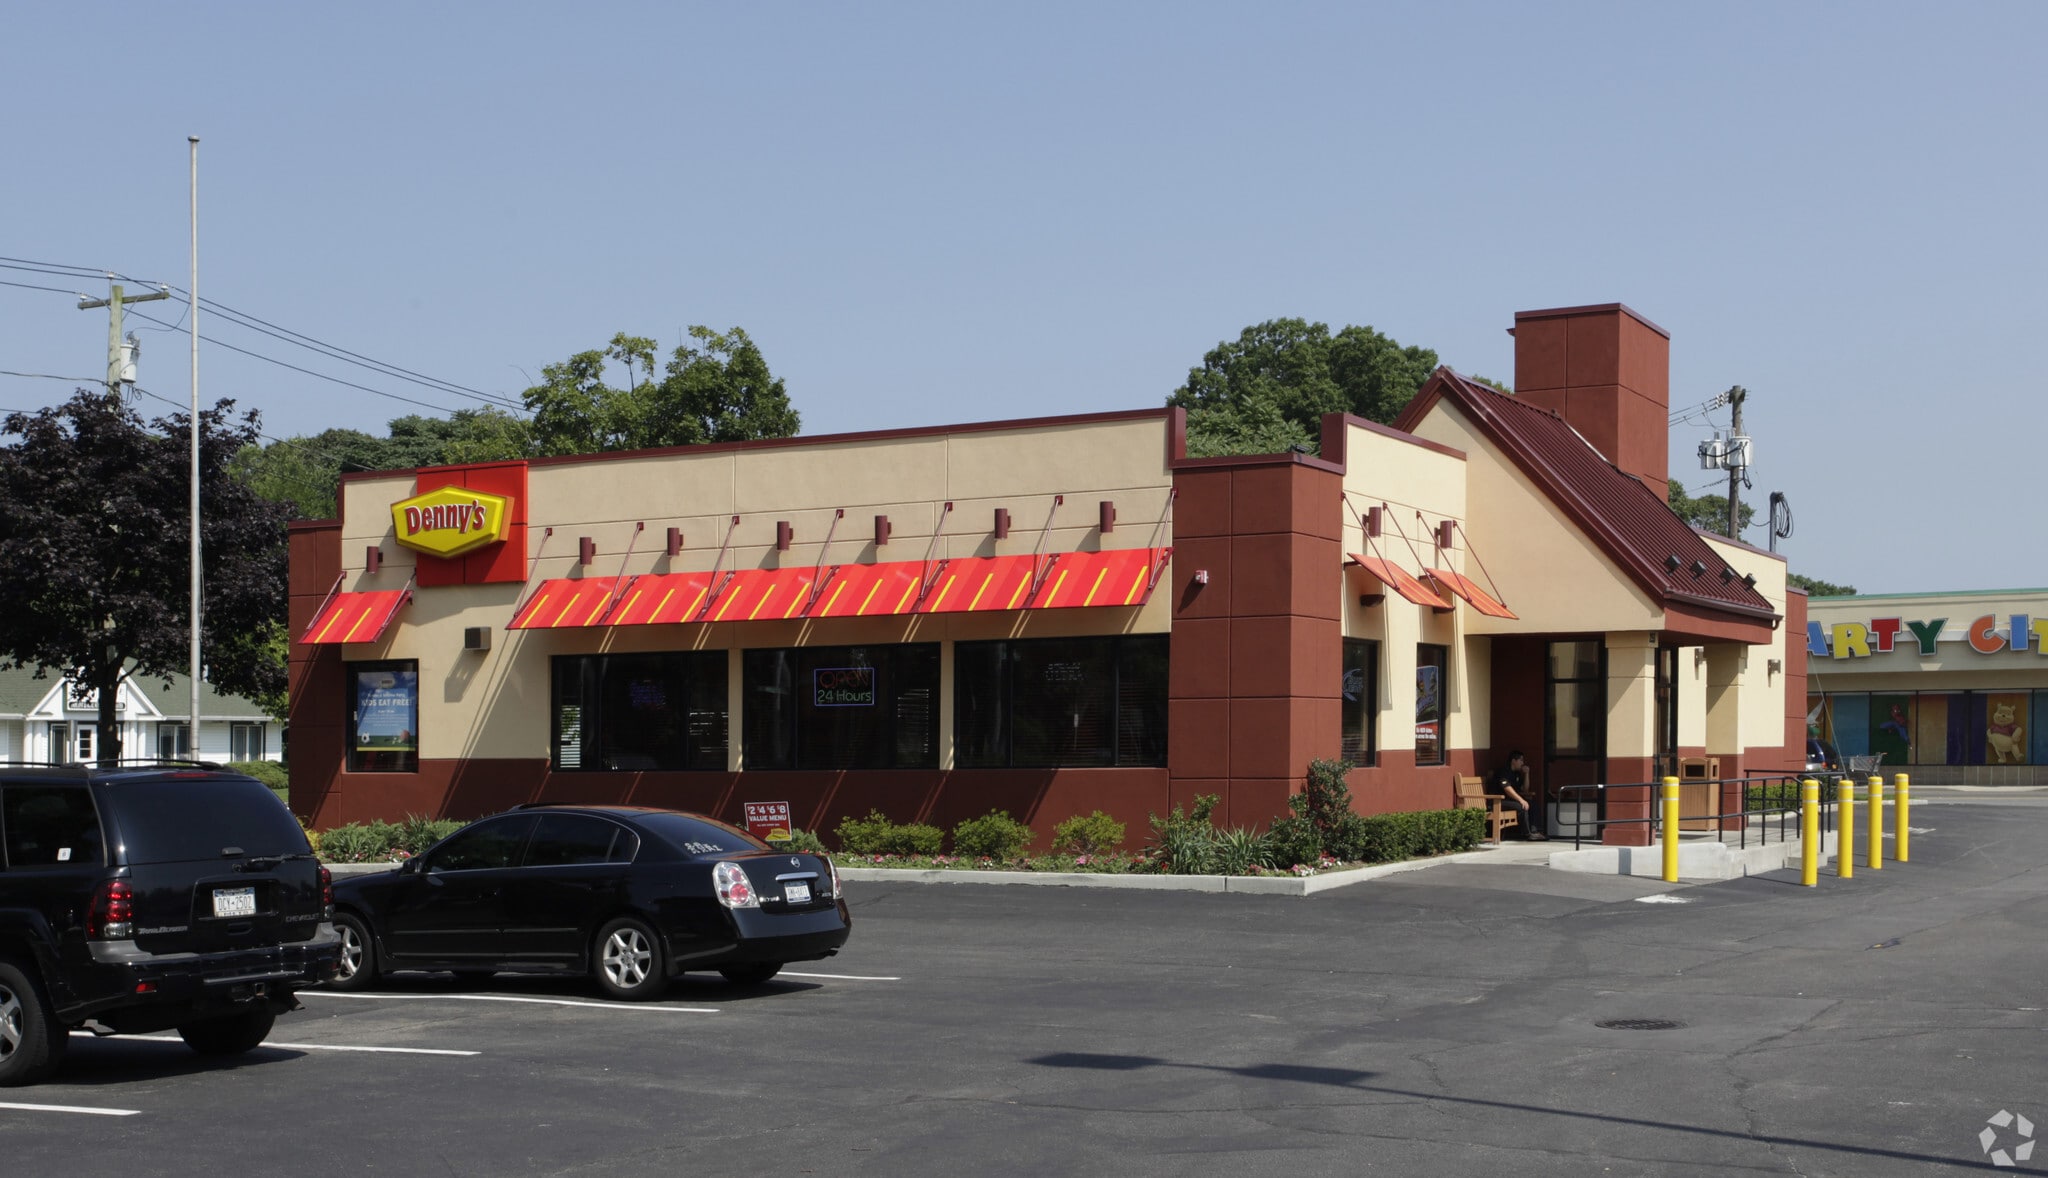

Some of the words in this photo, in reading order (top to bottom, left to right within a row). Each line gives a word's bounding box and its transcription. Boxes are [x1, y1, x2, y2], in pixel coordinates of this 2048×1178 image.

[405, 499, 486, 536] Denny's
[378, 698, 391, 706] EAT
[817, 689, 834, 702] 24
[836, 689, 872, 702] Hours
